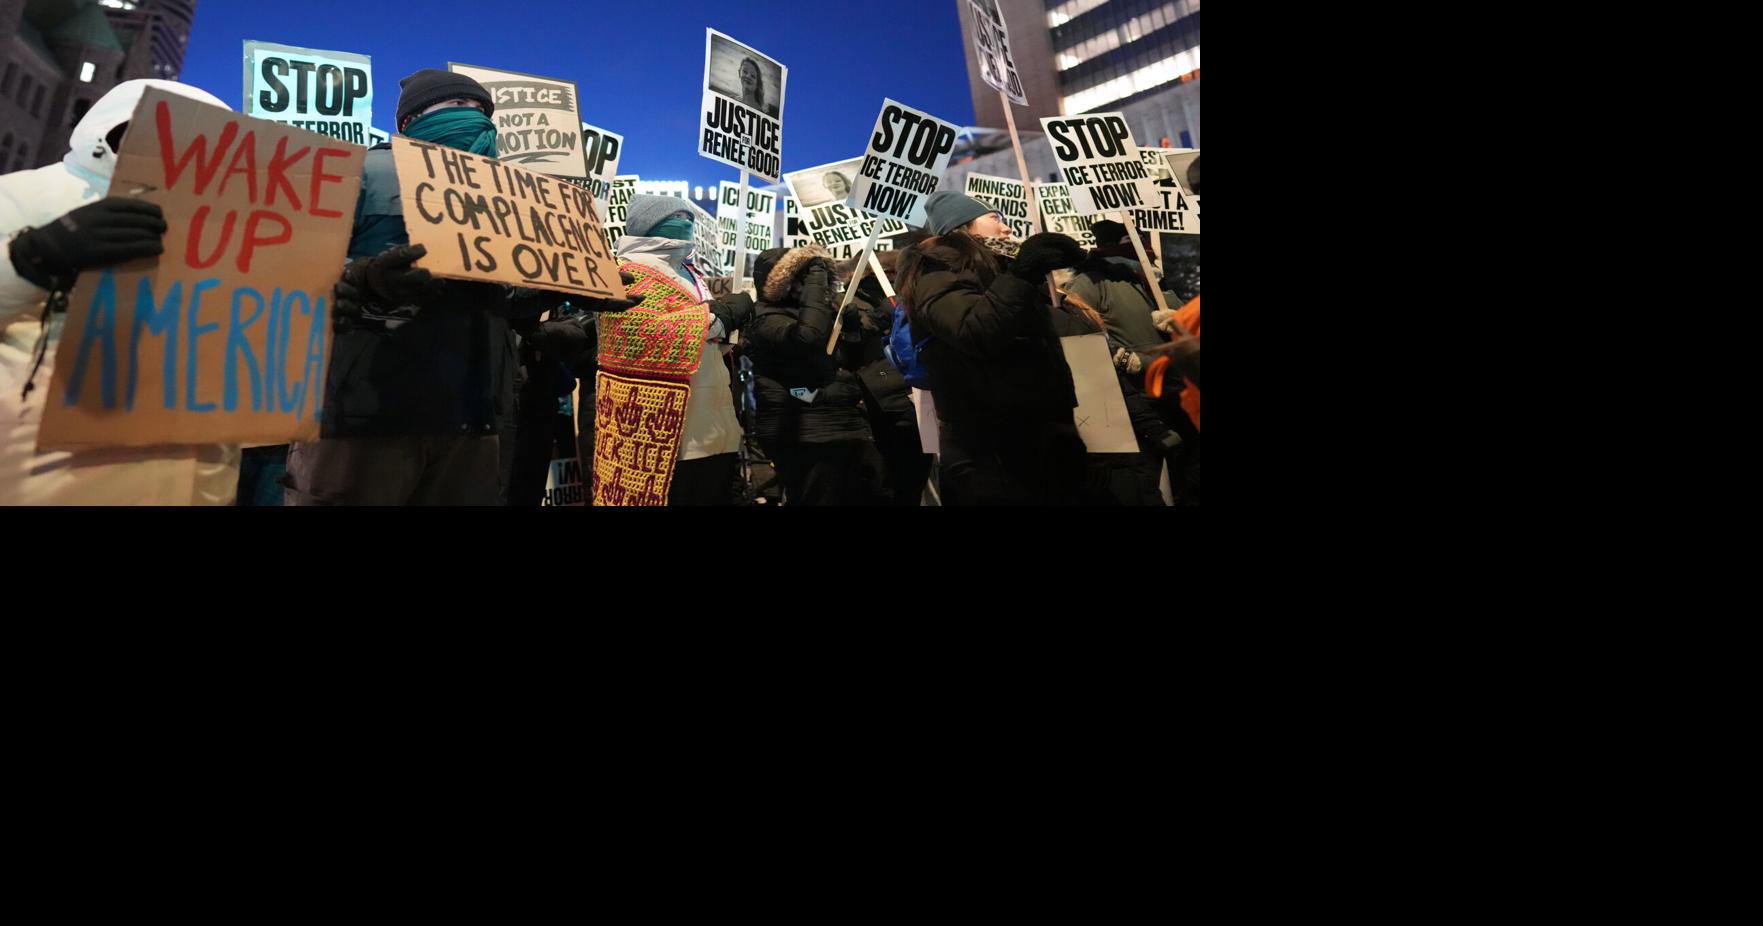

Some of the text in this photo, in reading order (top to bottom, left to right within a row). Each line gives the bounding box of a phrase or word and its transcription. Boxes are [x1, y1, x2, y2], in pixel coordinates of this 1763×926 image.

[259, 57, 368, 117] STOP
[498, 112, 549, 128] NOT A
[706, 96, 780, 155] JUSTICE
[871, 105, 956, 170] STOP
[1046, 116, 1129, 162] STOP
[155, 100, 352, 219] WAKE
[496, 129, 577, 156] MOTION
[583, 129, 619, 176] OP
[703, 127, 780, 180] RENEE GOOD
[409, 142, 599, 224] THE TIME FOR
[860, 154, 939, 196] ICE TERROR
[968, 177, 1035, 200] MINNESOT
[1062, 165, 1093, 187] ICE
[1092, 160, 1148, 183] TERROR
[747, 191, 773, 214] OUT
[864, 182, 918, 220] NOW!
[1088, 182, 1144, 211] NOW!
[1176, 191, 1189, 211] A
[185, 204, 293, 274] UP
[415, 182, 612, 262] COMPLACENCY
[813, 225, 862, 247] RENEE
[458, 232, 498, 273] IS
[512, 243, 609, 288] OVER
[62, 266, 329, 424] AMERICA
[628, 441, 672, 474] ICE
